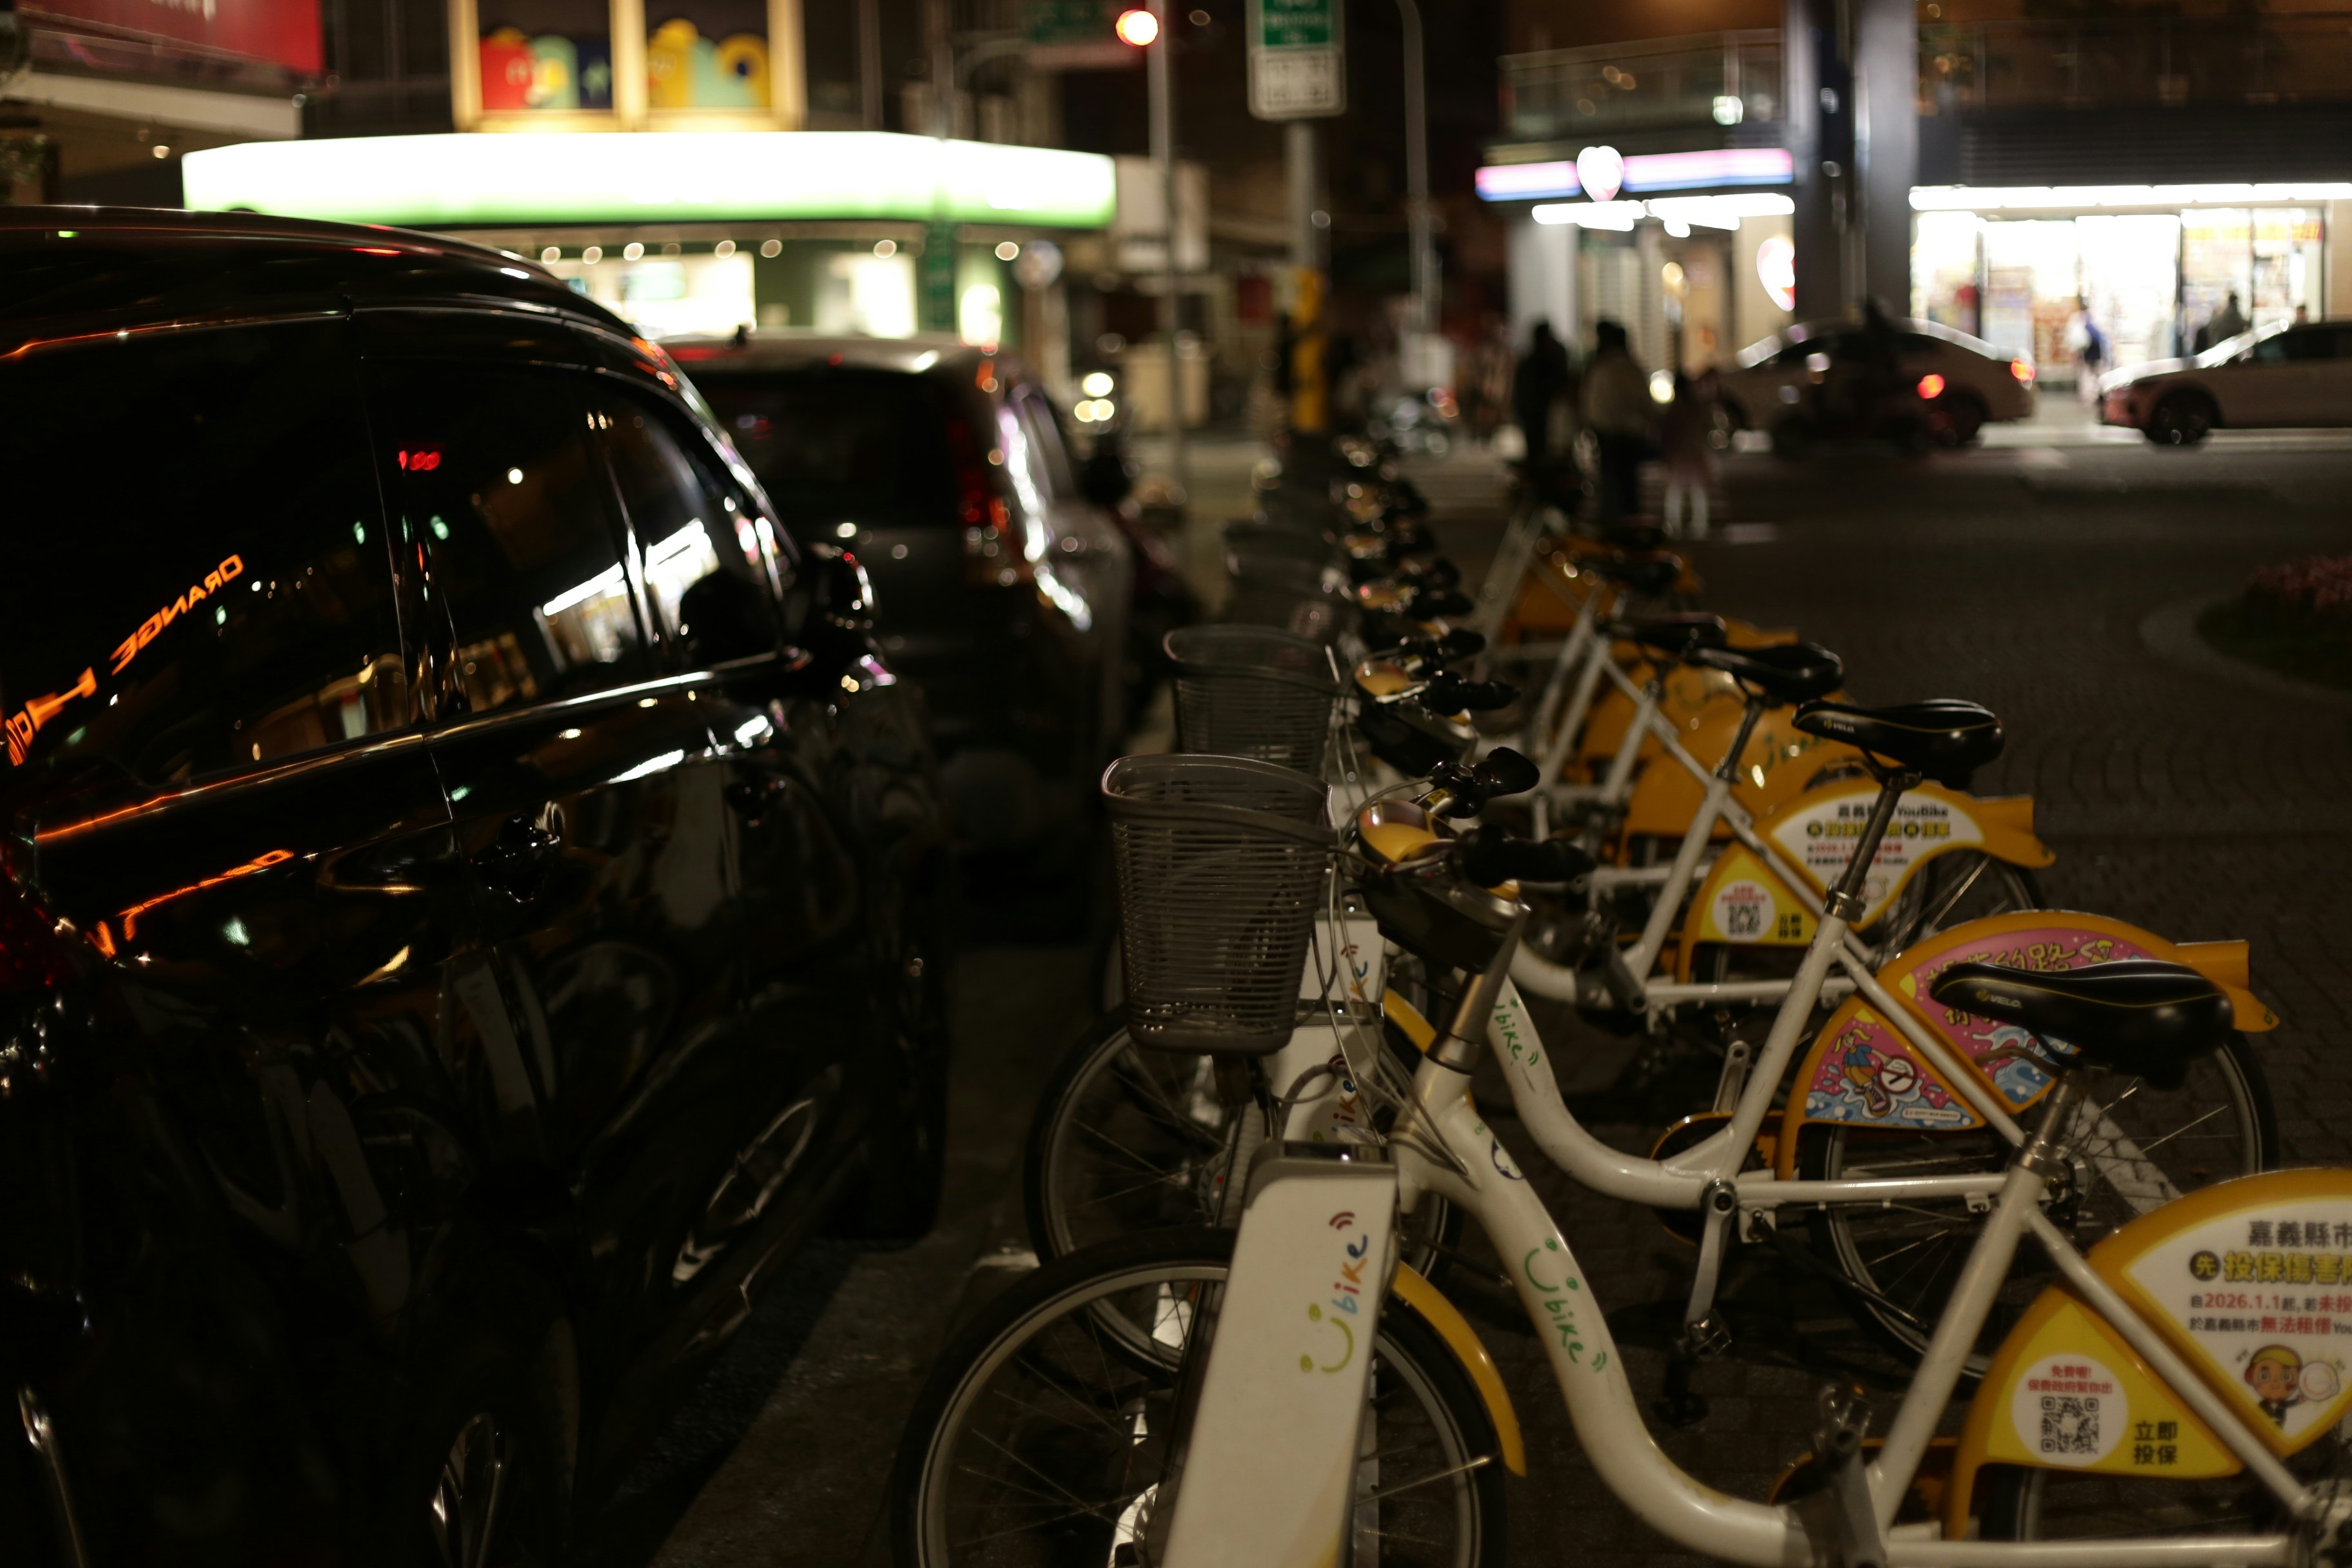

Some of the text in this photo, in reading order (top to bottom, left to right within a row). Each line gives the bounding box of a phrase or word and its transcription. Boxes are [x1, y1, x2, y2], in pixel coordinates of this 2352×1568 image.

[1990, 995, 2022, 1008] VELO
[2134, 1421, 2178, 1441] 立即
[2133, 1444, 2178, 1465] 投保
